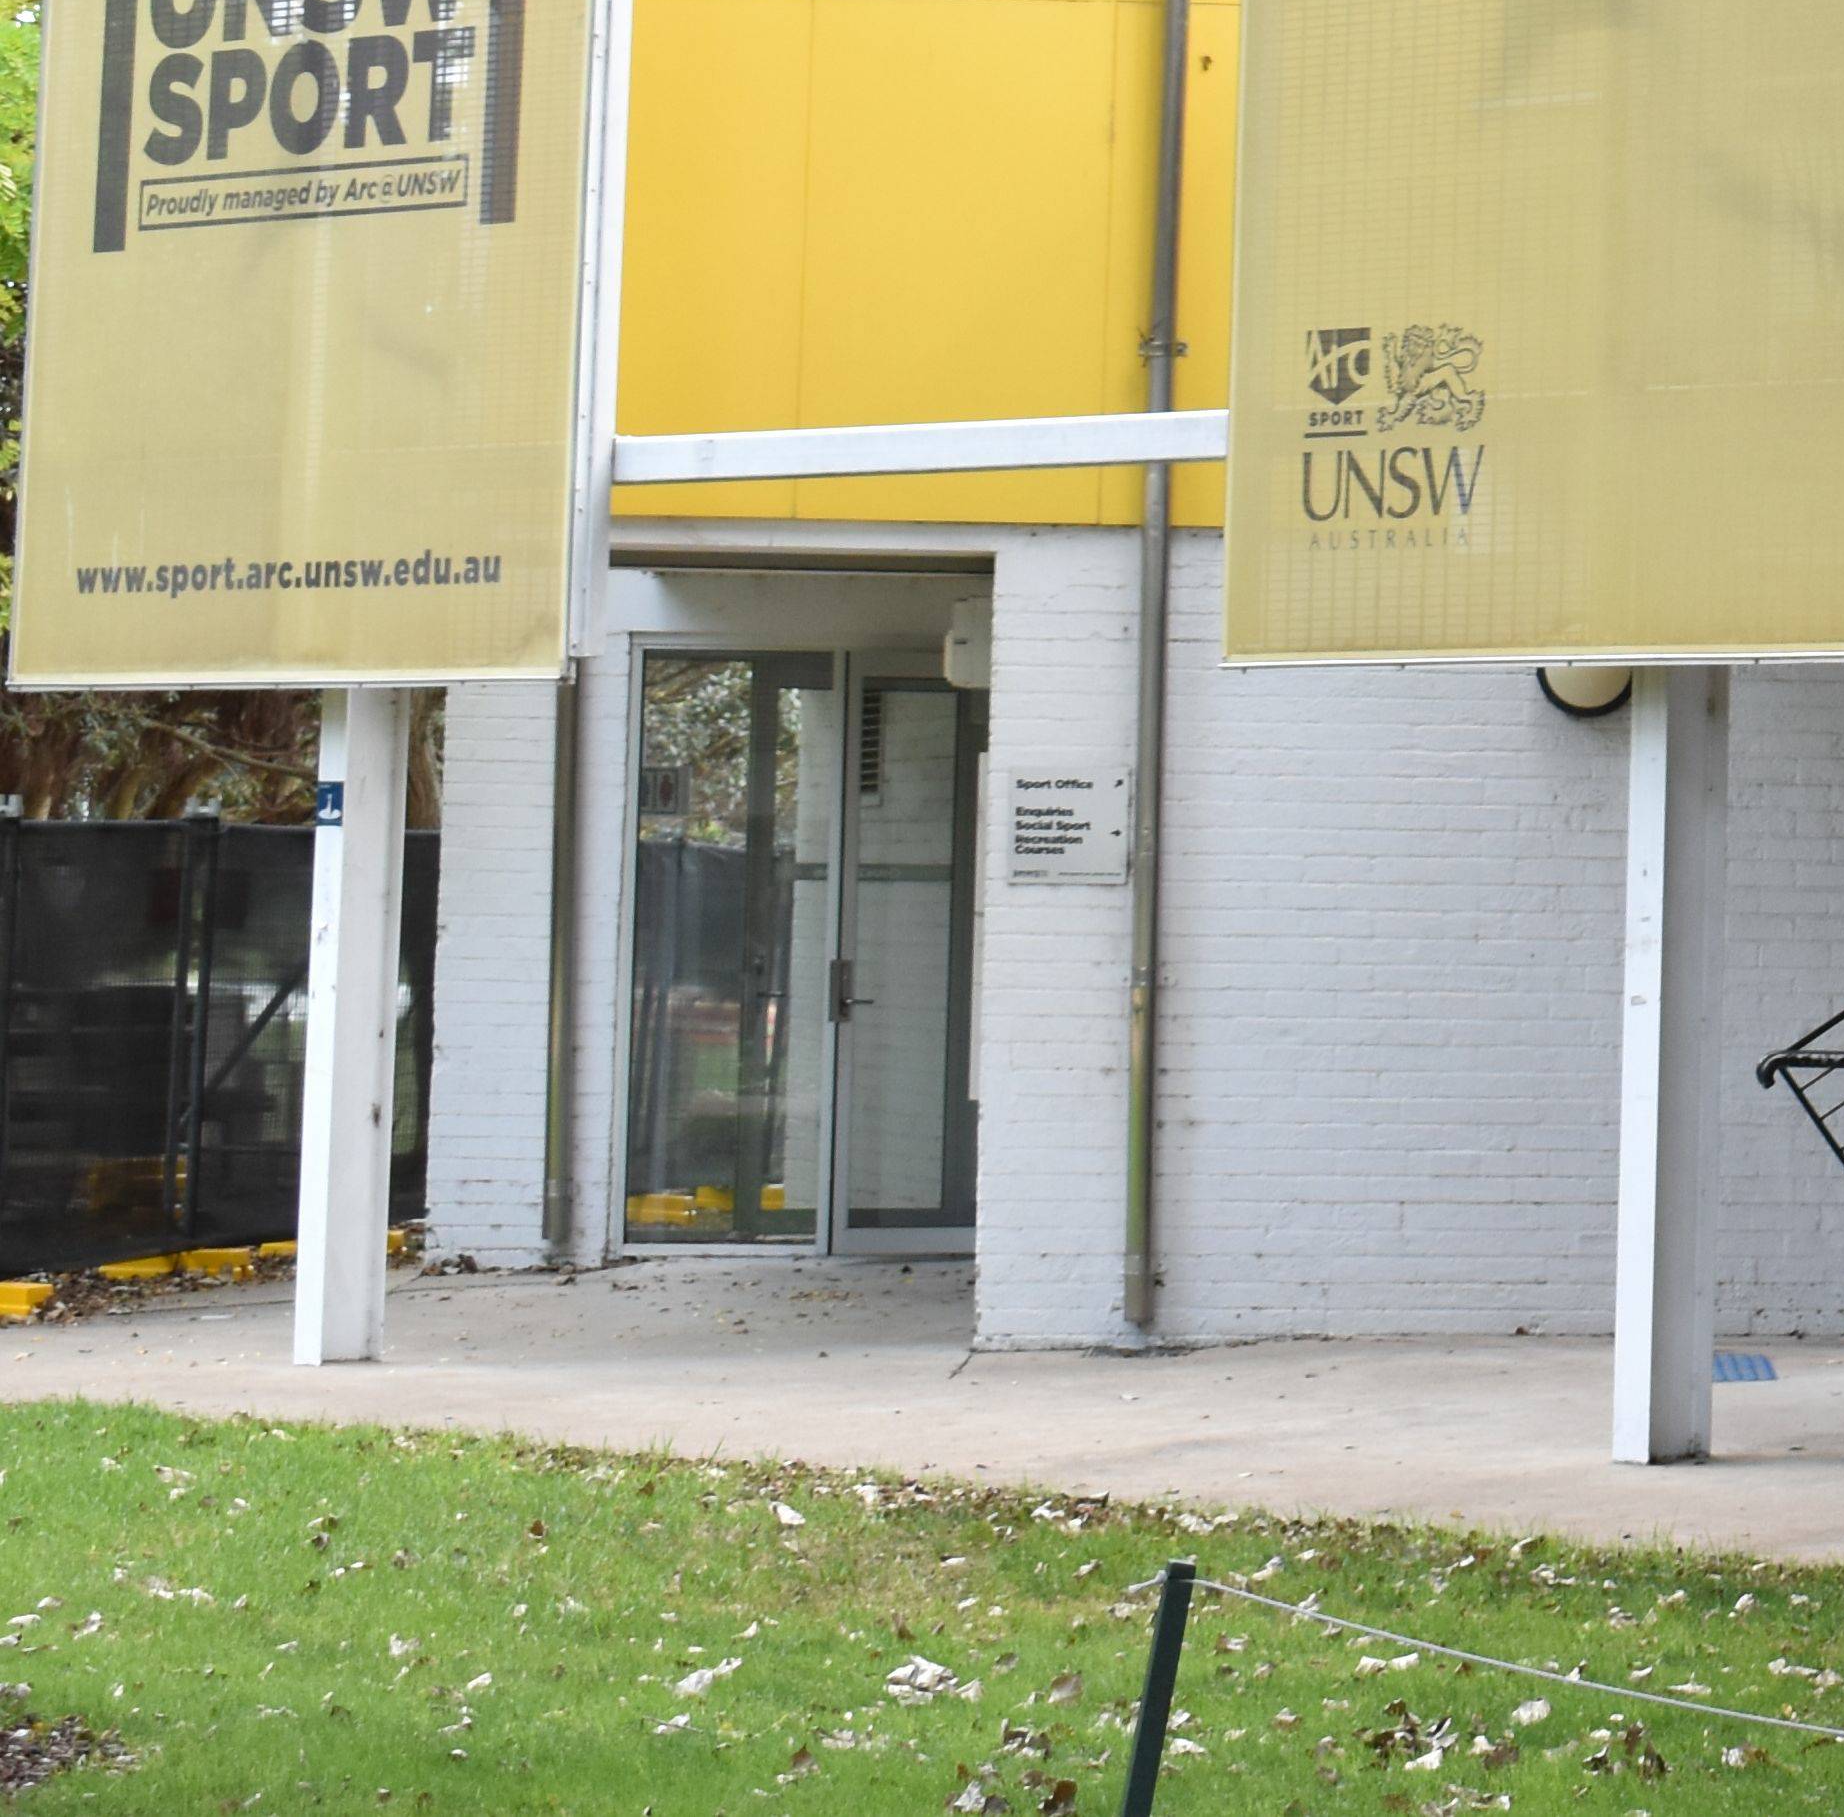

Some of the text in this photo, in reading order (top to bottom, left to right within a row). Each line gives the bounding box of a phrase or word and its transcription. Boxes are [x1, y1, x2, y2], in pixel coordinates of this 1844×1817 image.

[144, 27, 475, 166] SPORT
[147, 189, 217, 217] Proudly
[222, 180, 311, 214] managed
[315, 179, 340, 207] by
[1309, 411, 1363, 427] SPORT
[1302, 445, 1485, 522] UNSW
[1308, 528, 1469, 551] AUSTRALIA
[77, 549, 501, 598] www.sport.arc.unsw.edu.au
[1016, 779, 1093, 790] Sport Office
